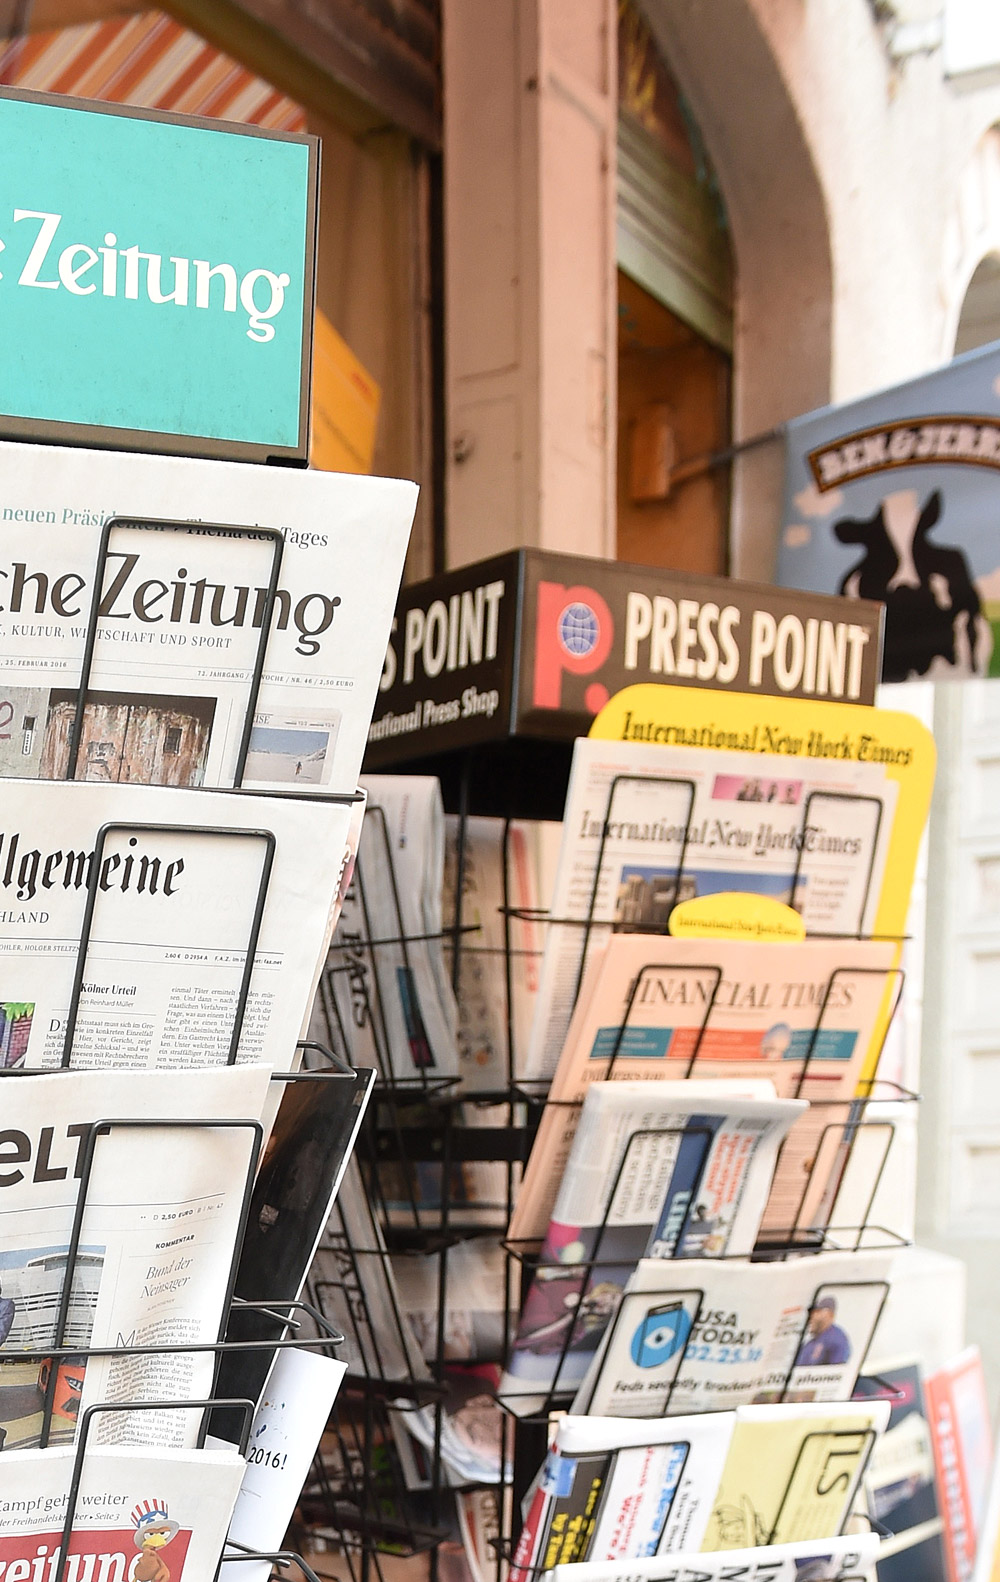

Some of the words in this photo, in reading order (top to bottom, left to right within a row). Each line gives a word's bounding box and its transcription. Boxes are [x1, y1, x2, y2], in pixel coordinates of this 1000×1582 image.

[14, 208, 291, 343] Zeitung
[2, 507, 57, 524] neuen
[62, 508, 169, 533] Präsienten
[279, 526, 330, 549] Tages
[98, 551, 342, 657] Zeitung
[10, 625, 67, 640] KULTUR,
[70, 627, 157, 645] WITSCHAFT
[159, 632, 188, 646] UND
[190, 635, 233, 650] SPORT
[402, 579, 506, 686] POINT
[624, 591, 741, 684] PRESS
[750, 609, 871, 700] POINT
[423, 699, 460, 728] Press
[461, 686, 499, 720] Shop
[621, 711, 760, 753] International
[760, 724, 803, 757] New
[807, 730, 852, 759] York
[855, 735, 914, 766] Times
[578, 810, 707, 846] International
[708, 818, 754, 849] New
[800, 826, 862, 857] Times
[111, 984, 138, 998] Urteil
[623, 975, 772, 1008] FINANCIAL
[781, 980, 857, 1011] TIMES
[155, 1233, 195, 1250] KOMMENTAR
[146, 1261, 172, 1280] Bund
[172, 1255, 194, 1273] der
[140, 1273, 192, 1300] Neinsager
[696, 1307, 739, 1328] USA
[690, 1325, 761, 1345] TODAY
[247, 1445, 288, 1472] 2016!
[44, 1495, 78, 1512] geh
[81, 1493, 130, 1508] weiter
